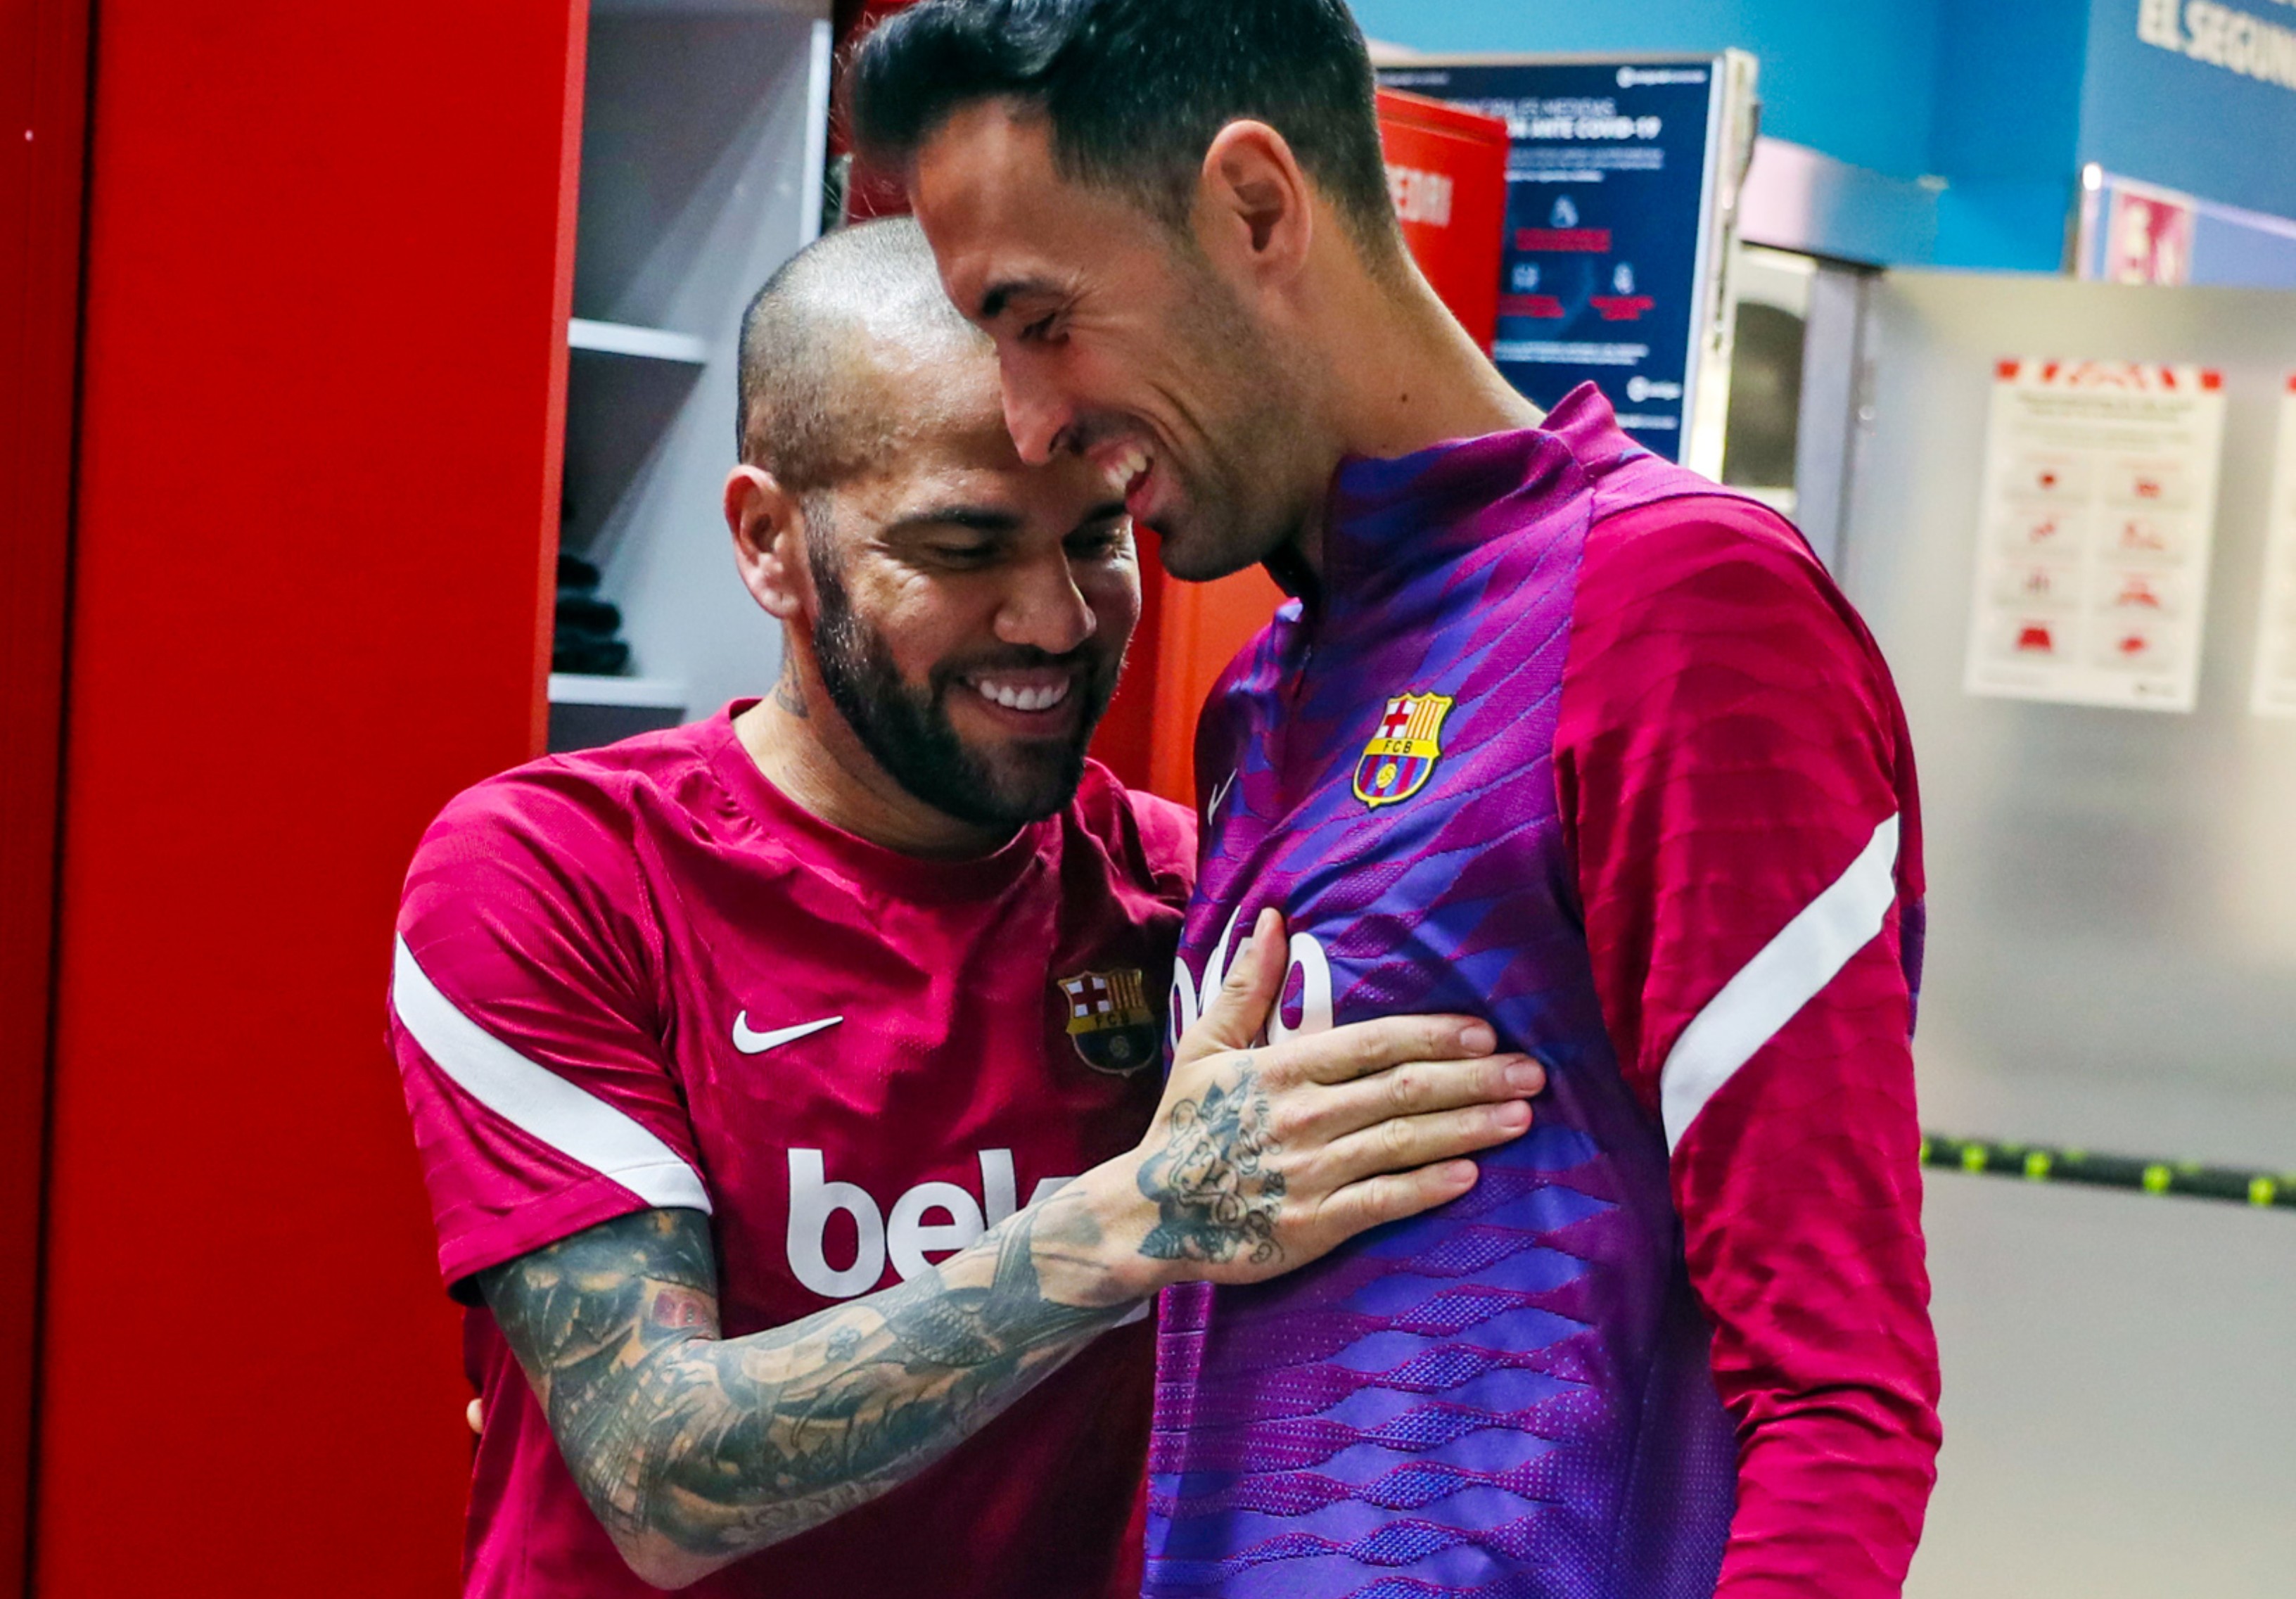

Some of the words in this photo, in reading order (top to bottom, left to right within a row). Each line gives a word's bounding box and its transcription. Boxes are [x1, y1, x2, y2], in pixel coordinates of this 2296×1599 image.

[1574, 115, 1662, 140] COVID-19
[1384, 166, 1453, 229] EDRI
[1383, 740, 1413, 754] FCB
[786, 1148, 1149, 1328] bek
